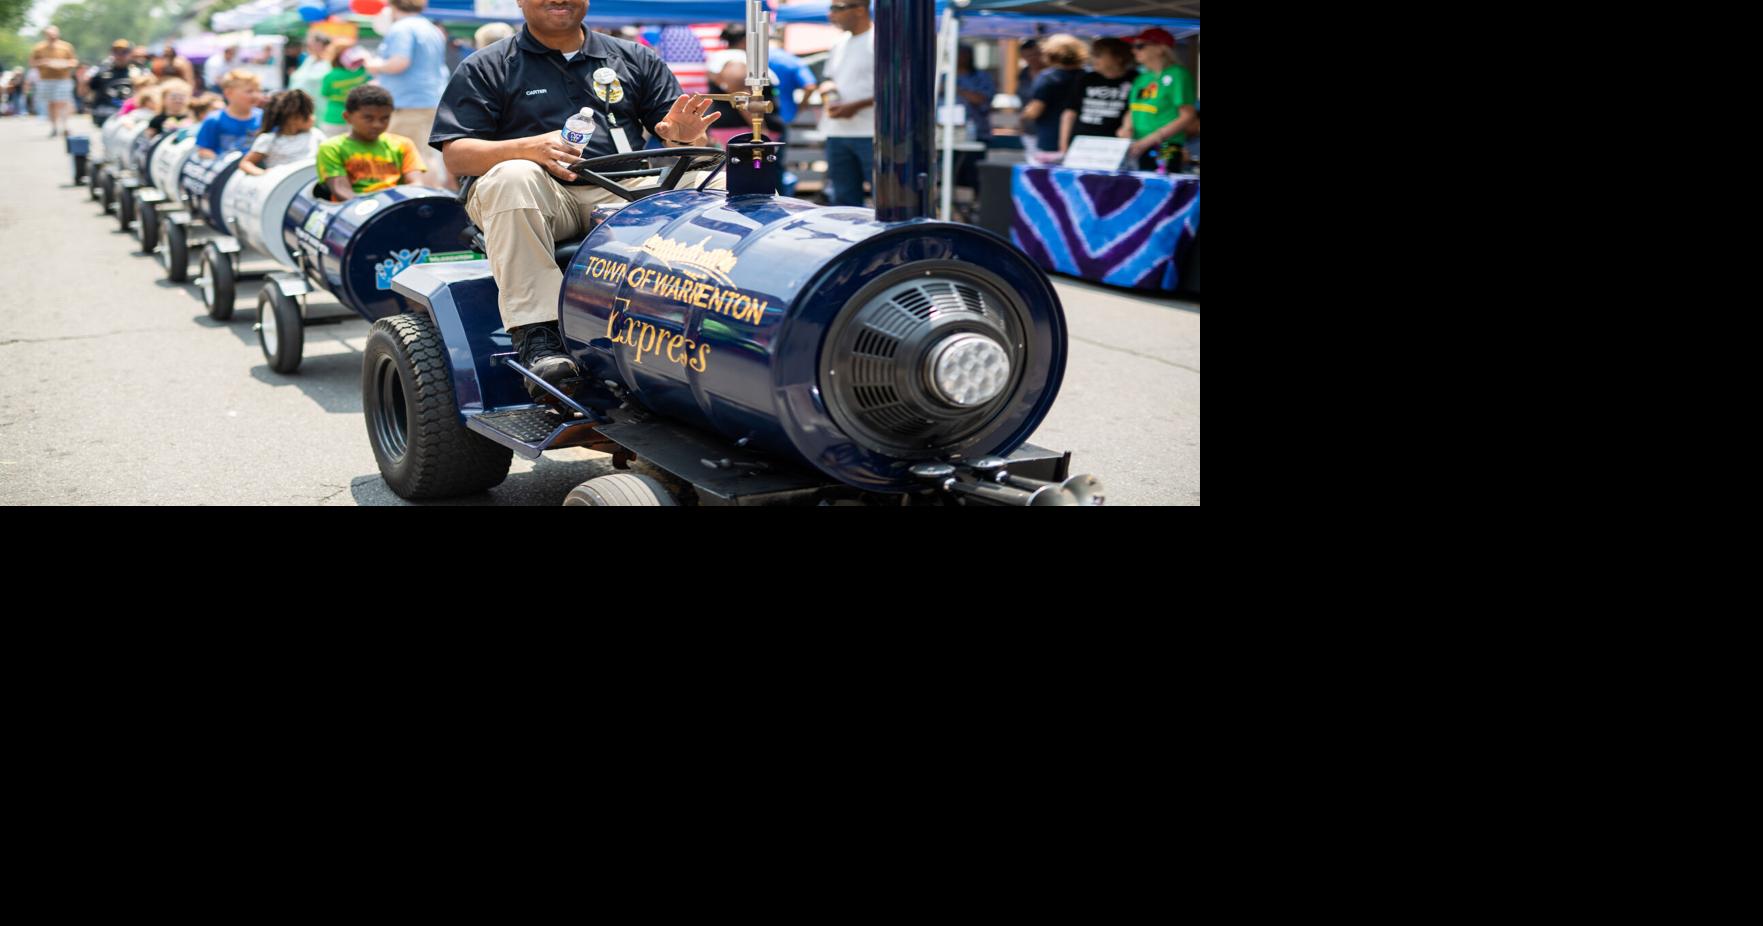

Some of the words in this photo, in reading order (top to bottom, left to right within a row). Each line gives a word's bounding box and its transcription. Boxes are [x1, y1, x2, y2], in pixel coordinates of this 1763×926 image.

[586, 256, 628, 284] TOWN
[627, 266, 656, 290] OF
[606, 297, 711, 372] Express
